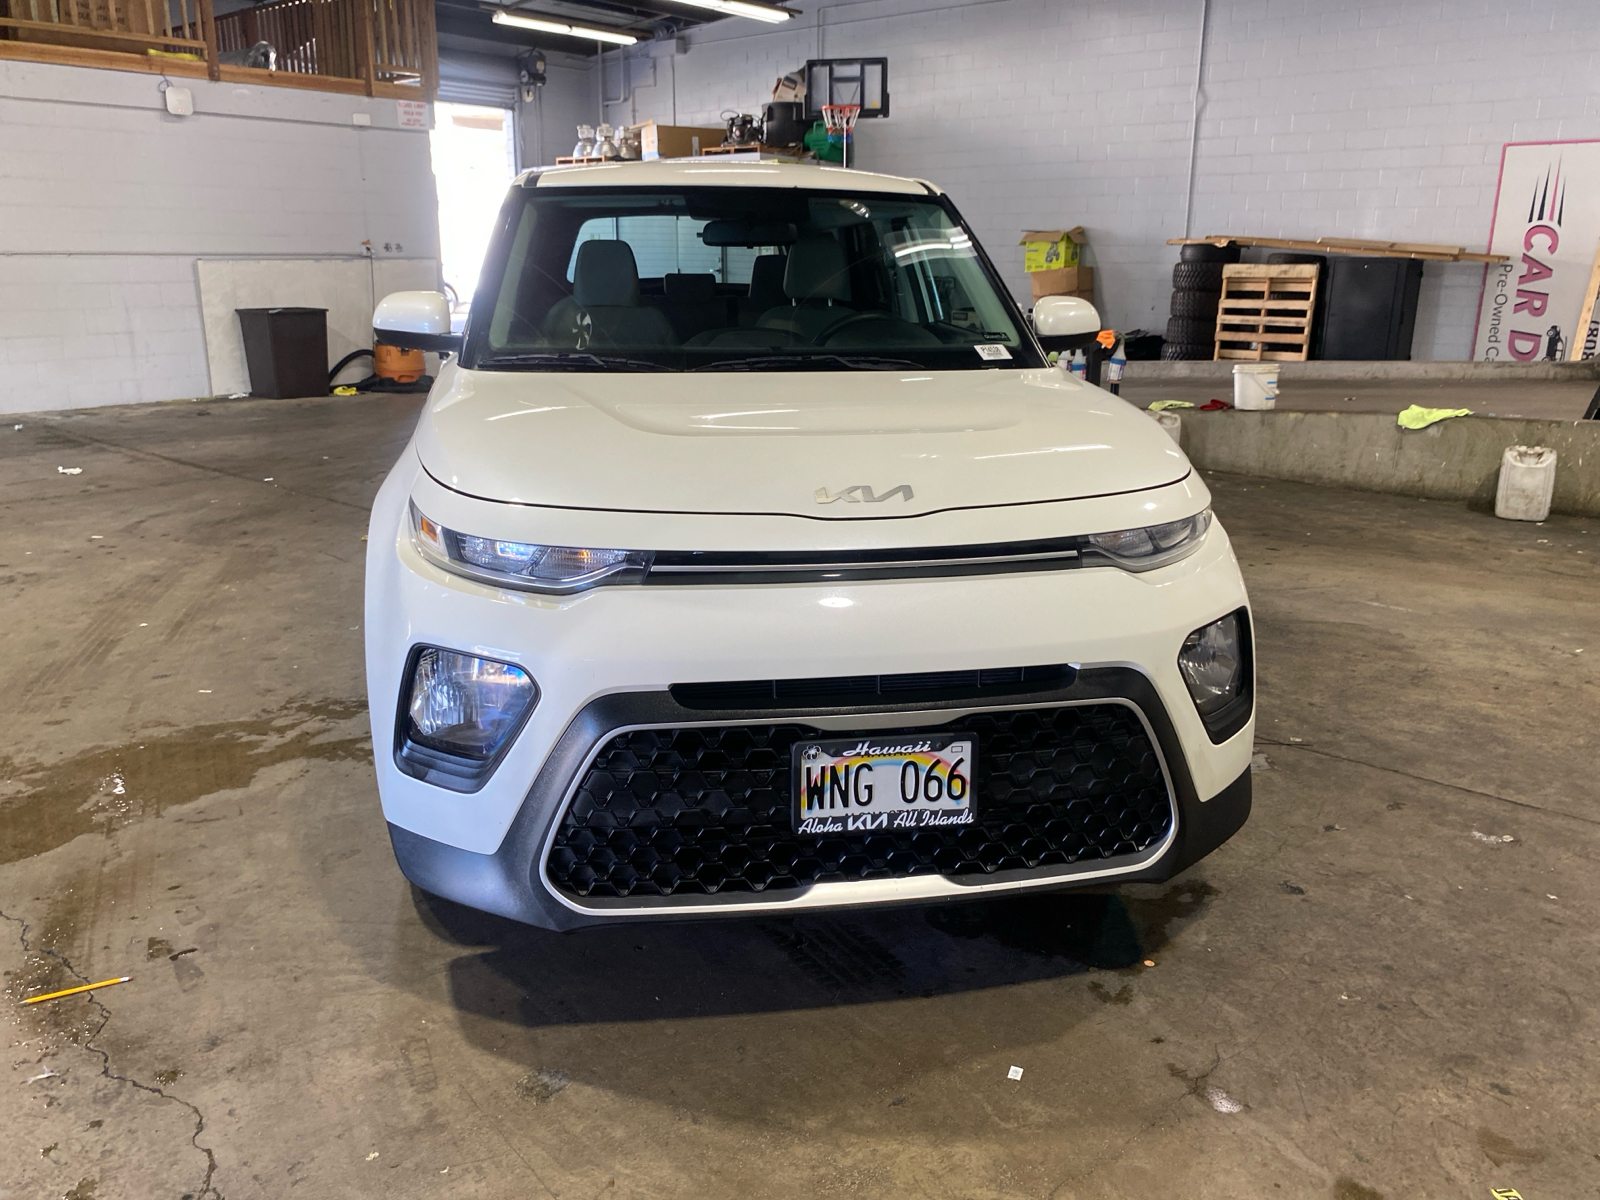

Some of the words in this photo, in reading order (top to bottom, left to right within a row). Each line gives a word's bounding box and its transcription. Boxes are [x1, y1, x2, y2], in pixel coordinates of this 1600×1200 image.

[1513, 224, 1559, 317] CAR
[1488, 264, 1513, 343] Pre-Owned
[814, 484, 914, 504] KIA
[842, 740, 931, 757] Hawaii
[805, 763, 873, 810] WNG
[901, 757, 966, 803] 066
[798, 818, 843, 834] Aloha
[847, 813, 888, 830] KIA
[893, 811, 917, 827] All
[919, 808, 974, 827] Islands
